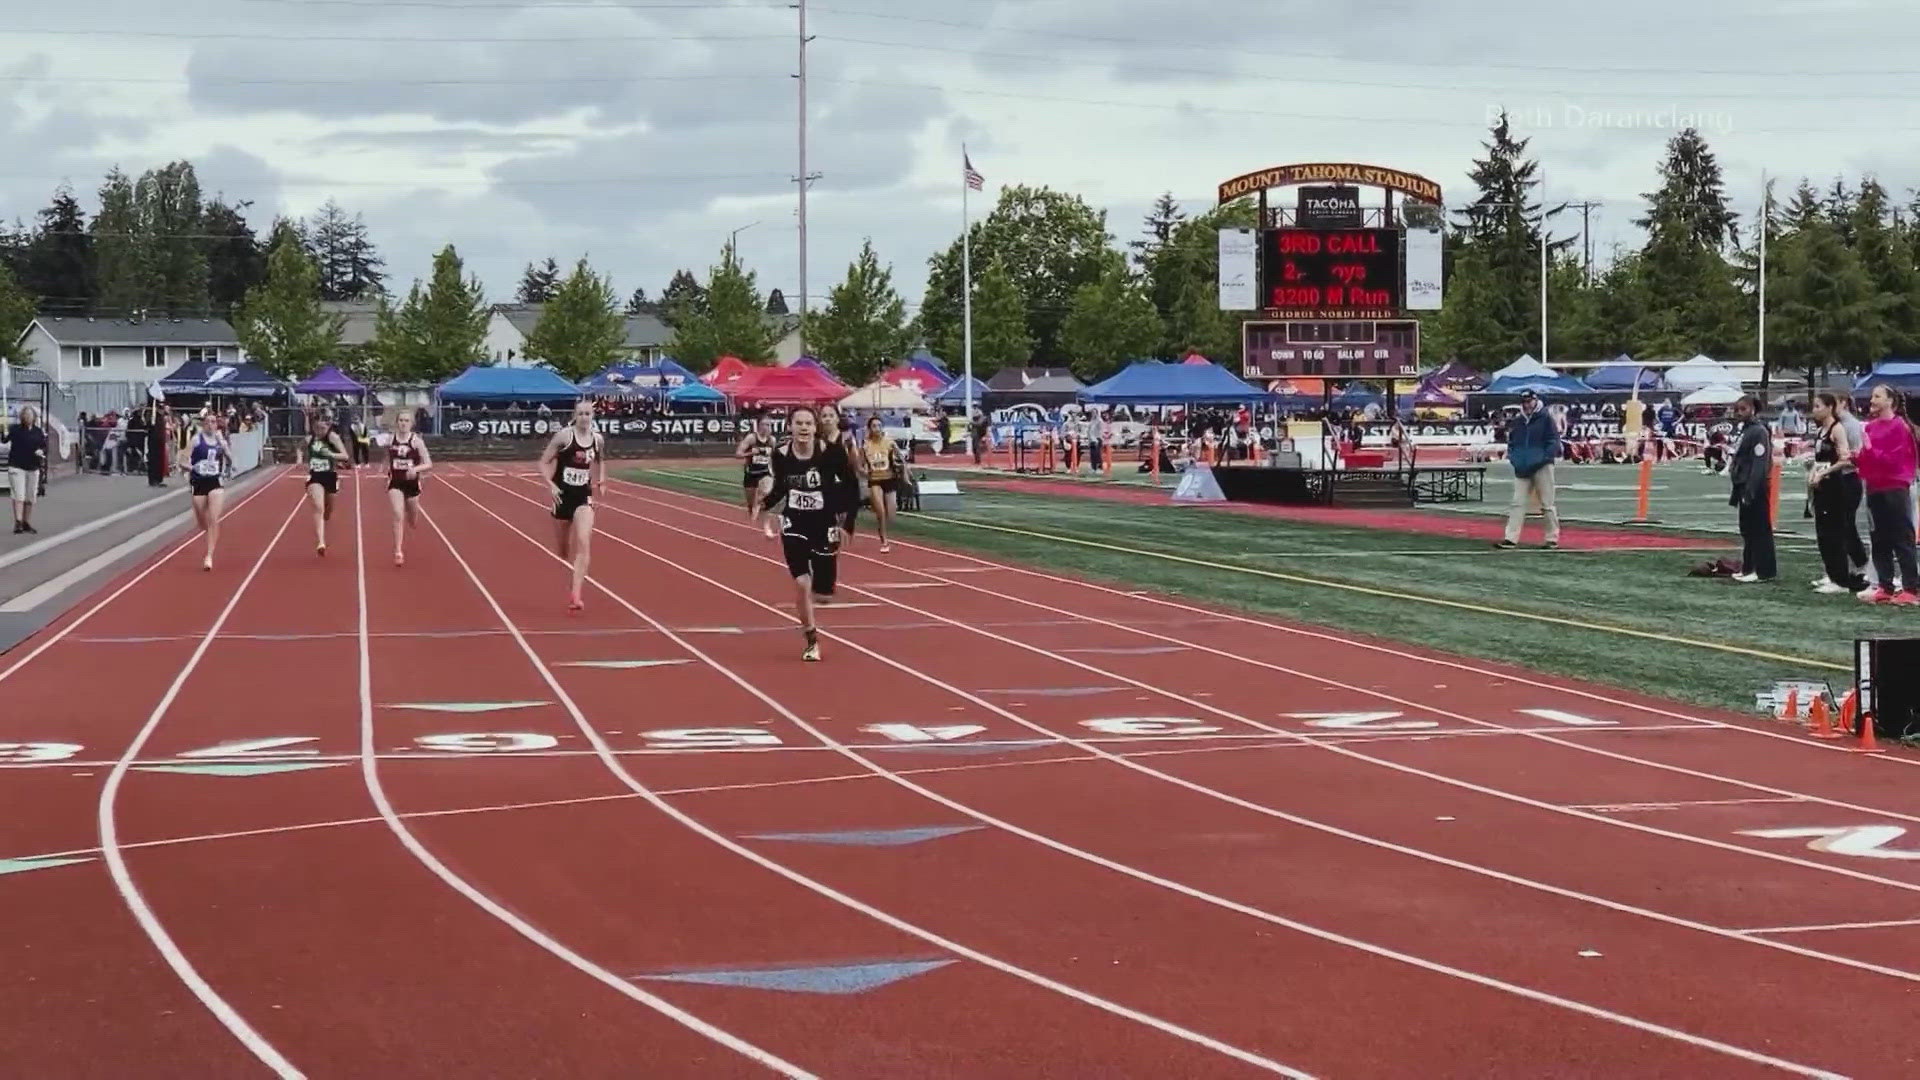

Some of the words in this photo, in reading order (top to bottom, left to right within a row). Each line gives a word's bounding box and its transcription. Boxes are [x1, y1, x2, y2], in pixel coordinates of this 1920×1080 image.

[1222, 170, 1284, 198] MOUNT
[1290, 165, 1361, 181] TAHOMA
[1364, 169, 1439, 198] STADIUM
[1305, 197, 1357, 210] TACOMA
[1280, 235, 1321, 253] 3RD
[1328, 235, 1382, 253] CALL
[1274, 287, 1320, 306] 3200
[1350, 287, 1390, 305] Run
[1271, 311, 1315, 319] GEORGE
[1360, 311, 1392, 319] FIELD
[1271, 351, 1295, 360] DOWN
[1303, 351, 1313, 360] TO
[1313, 351, 1325, 360] GO
[1337, 350, 1353, 360] BALL
[1374, 350, 1390, 359] QTR
[478, 419, 531, 434] STATE
[651, 419, 704, 434] STATE
[1454, 425, 1495, 437] STAT
[1077, 717, 1224, 735] 3
[1277, 711, 1439, 729] 2
[638, 728, 783, 748] 5
[856, 723, 988, 742] 4
